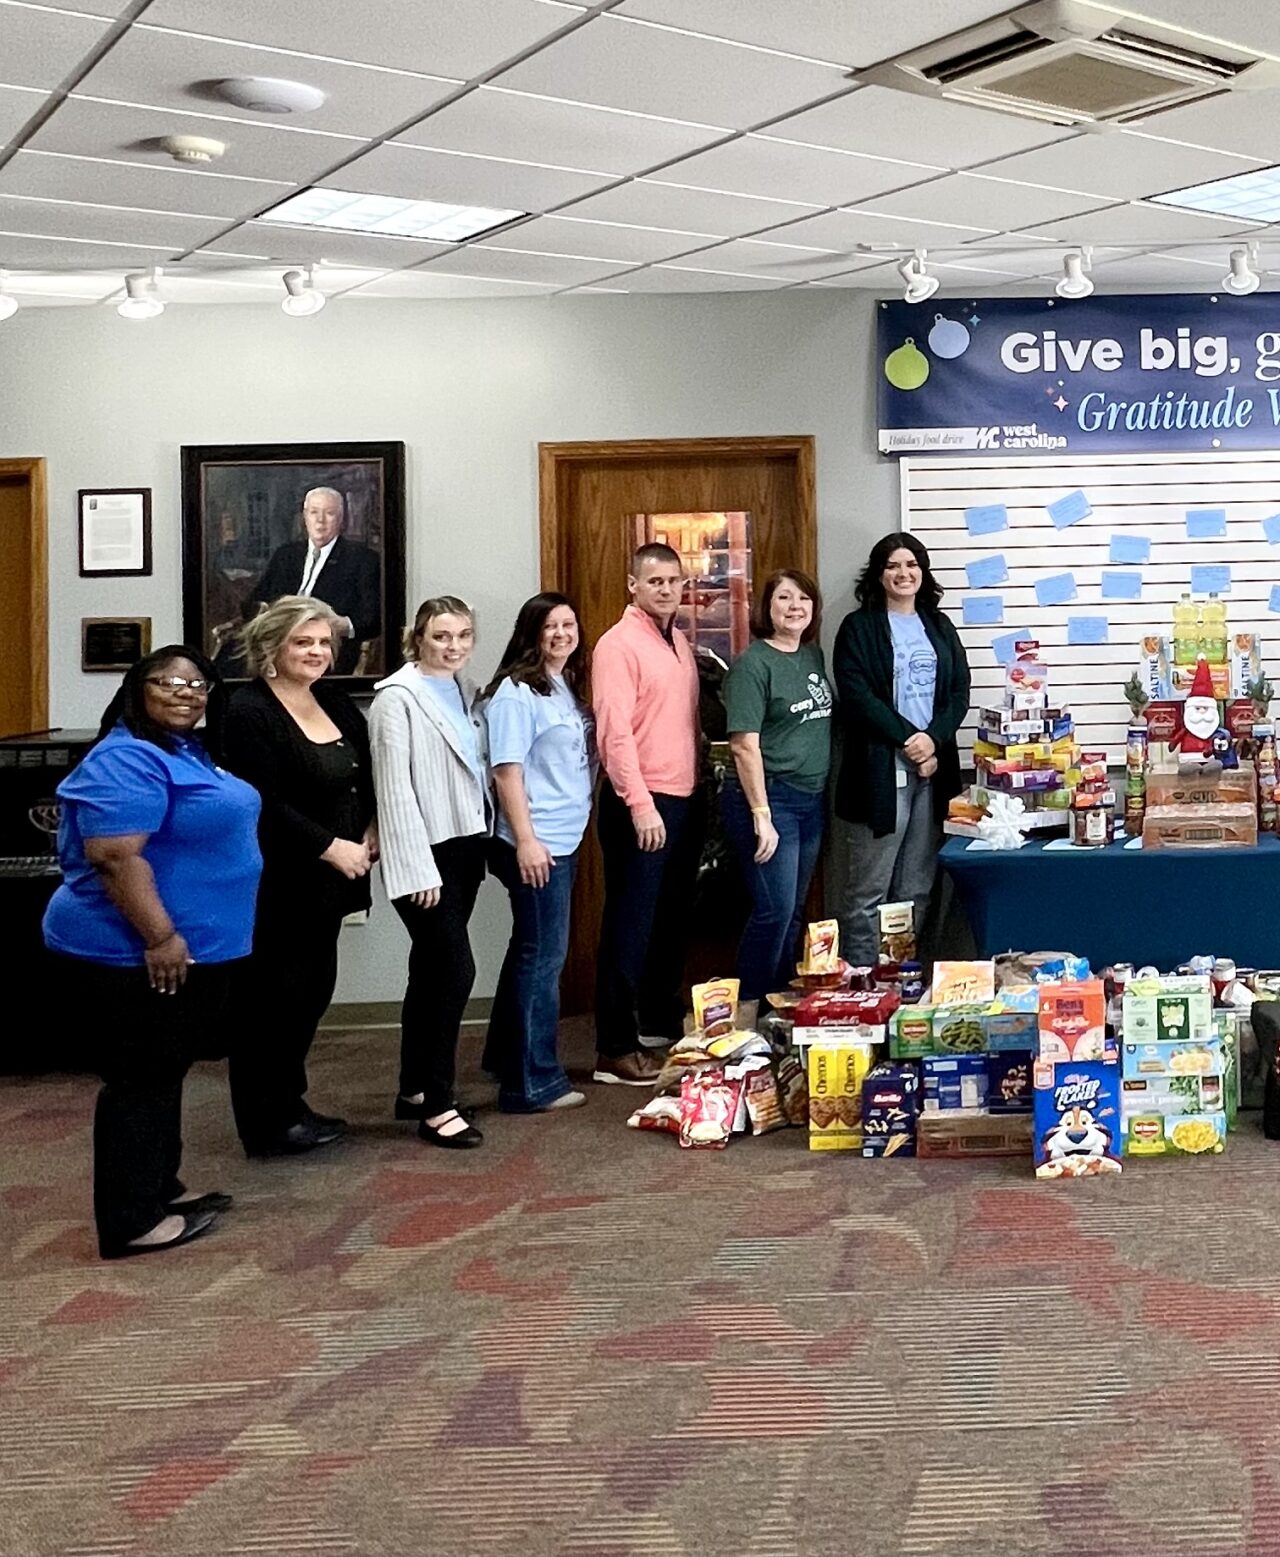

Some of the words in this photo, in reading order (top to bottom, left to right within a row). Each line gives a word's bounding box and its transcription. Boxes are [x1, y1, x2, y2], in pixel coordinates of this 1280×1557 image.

[1000, 331, 1124, 373] Give
[1141, 327, 1240, 376] big,
[1077, 385, 1252, 432] Gratitude
[889, 435, 920, 446] Holiday
[922, 434, 941, 446] food
[942, 433, 964, 444] drive
[1003, 423, 1037, 437] west
[1003, 434, 1067, 449] carolina
[1150, 658, 1160, 700] SALTINE
[1241, 656, 1250, 697] SALTINE
[1054, 1079, 1101, 1098] FROSTED
[1057, 1091, 1096, 1107] FLAKES
